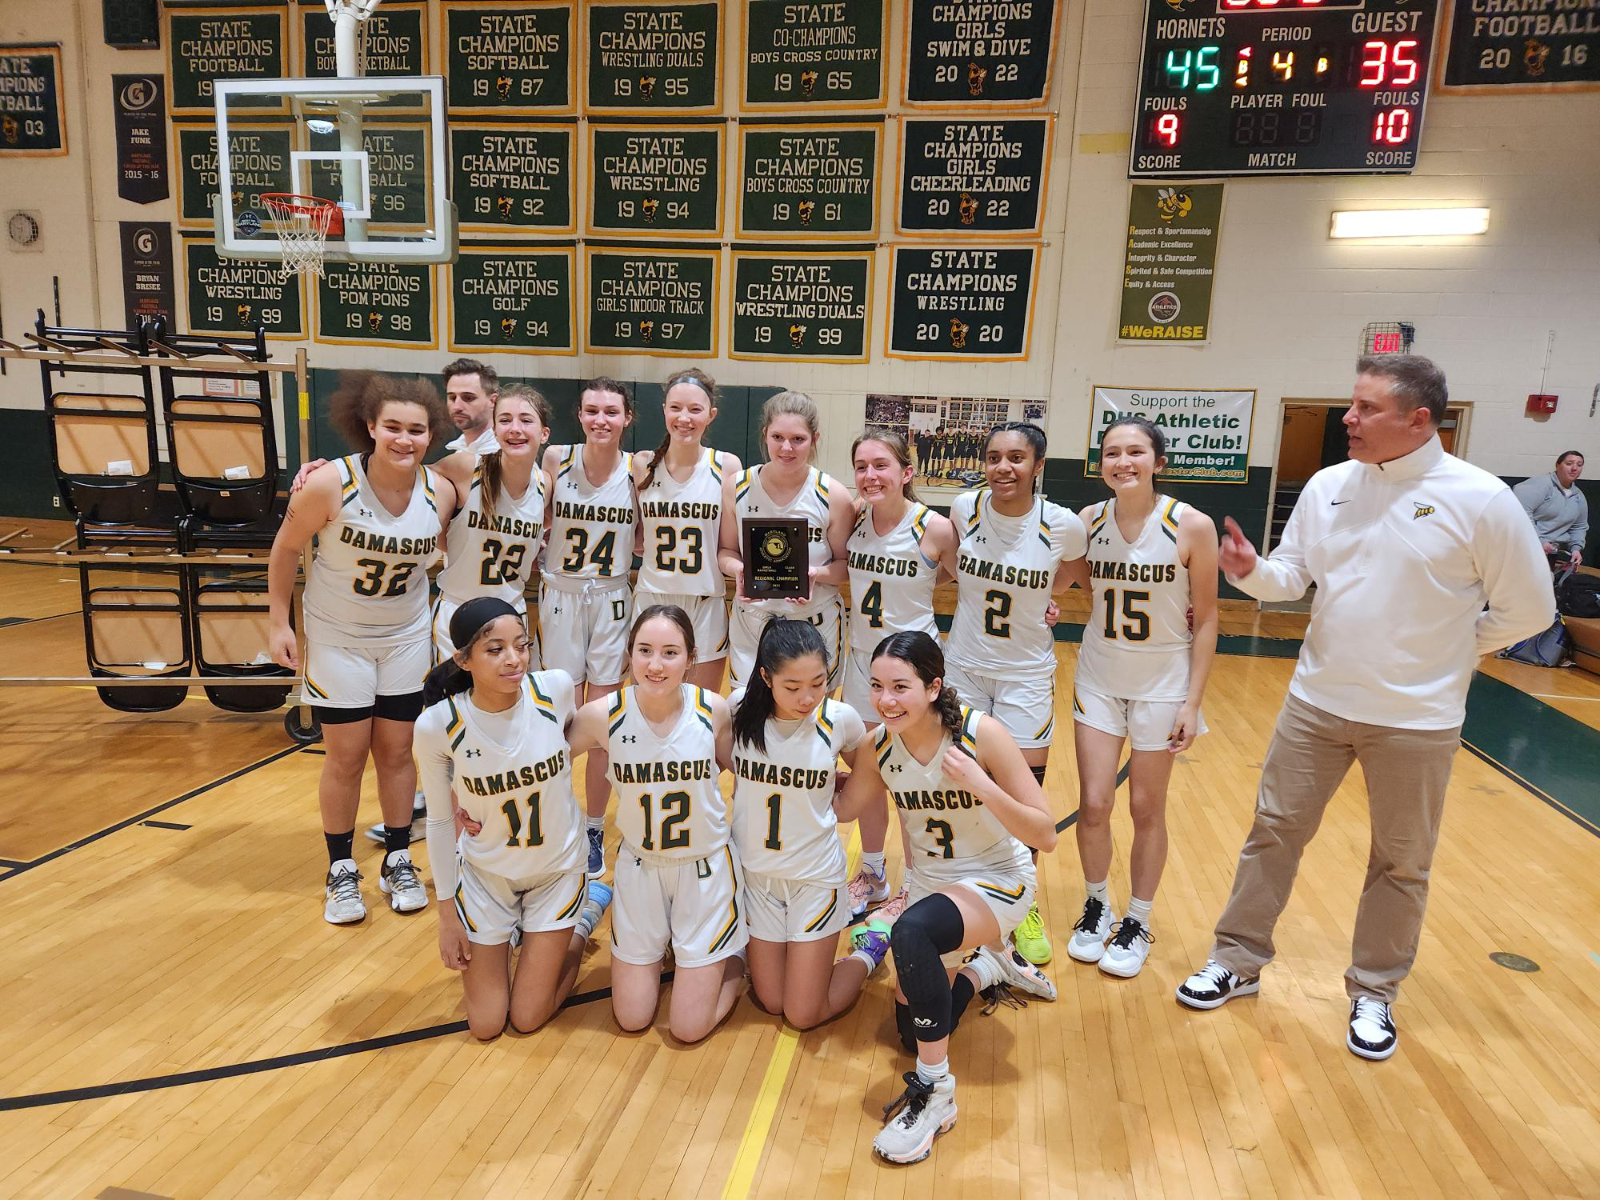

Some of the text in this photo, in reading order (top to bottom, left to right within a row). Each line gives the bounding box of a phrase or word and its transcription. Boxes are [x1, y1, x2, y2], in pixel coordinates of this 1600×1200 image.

[623, 12, 683, 31] STATE
[784, 2, 846, 24] STATE
[933, 3, 1032, 22] CHAMPIONS
[200, 21, 251, 38] STATE
[481, 15, 536, 34] STATE
[955, 21, 1006, 39] GIRLS
[1156, 17, 1226, 39] HORNETS
[1351, 12, 1423, 33] GUEST
[1473, 12, 1600, 37] FOOTBALL
[600, 31, 706, 50] CHAMPIONS
[773, 26, 856, 47] CO-CHAMPIONS
[1261, 27, 1312, 42] PERIOD
[181, 40, 272, 56] CHAMPIONS
[458, 34, 559, 54] CHAMPIONS
[927, 38, 1031, 57] SWIM & DIVE
[467, 54, 549, 71] SOFTBALL
[602, 51, 704, 68] WRESTLING DUALS
[750, 48, 878, 64] BOYS CROSS COUNTRY
[1359, 40, 1418, 87] 35
[1480, 44, 1588, 69] 20 16
[189, 58, 264, 73] FOOTBALL
[935, 63, 1019, 83] 20 22
[1166, 46, 1220, 89] 45
[1272, 51, 1293, 81] 4
[198, 81, 213, 96] 19
[473, 78, 544, 96] 19 87
[614, 78, 689, 96] 19 95
[774, 71, 852, 92] 19 65
[1144, 96, 1187, 111] FOULS
[1230, 93, 1327, 109] PLAYER FOUL
[1373, 91, 1420, 105] FOULS
[25, 119, 44, 135] 03
[131, 128, 149, 136] JAKE
[944, 125, 1003, 142] STATE
[1157, 114, 1179, 146] 9
[1375, 109, 1410, 144] 10
[483, 136, 538, 155] STATE
[626, 137, 685, 156] STATE
[779, 138, 840, 156] STATE
[924, 142, 1022, 159] CHAMPIONS
[461, 155, 560, 175] CHAMPIONS
[603, 157, 707, 176] CHAMPIONS
[754, 158, 863, 176] CHAMPIONS
[946, 159, 996, 175] GIRLS
[1138, 155, 1181, 169] SCORE
[1248, 153, 1297, 167] MATCH
[1366, 151, 1412, 166] SCORE
[124, 170, 159, 179] 2015 16
[470, 172, 550, 191] SOFTBALL
[610, 175, 700, 192] WRESTLING
[910, 175, 1031, 192] CHEERLEADING
[746, 177, 871, 195] BOYS CROSS COUNTRY
[383, 194, 405, 211] 96
[474, 196, 544, 216] 19 92
[617, 200, 690, 219] 19 94
[928, 199, 1010, 217] 20 22
[772, 203, 842, 221] 19 61
[1129, 226, 1211, 236] Respect Sportsmanship
[1128, 239, 1159, 248] Academic
[930, 251, 998, 269] STATE
[1128, 252, 1155, 262] Integrity
[136, 274, 159, 282] BRYAN
[198, 268, 287, 285] CHAMPIONS
[483, 261, 537, 278] STATE
[623, 261, 679, 279] STATE
[771, 265, 830, 283] STATE
[1126, 265, 1151, 275] Spirited
[328, 273, 420, 292] CHAMPIONS
[462, 279, 559, 297] CHAMPIONS
[601, 279, 702, 299] CHAMPIONS
[907, 274, 1017, 292] CHAMPIONS
[1124, 278, 1143, 288] Equity
[205, 285, 282, 300] WRESTLING
[340, 291, 410, 307] POM PONS
[747, 283, 853, 302] CHAMPIONS
[492, 297, 531, 312] GOLF
[597, 297, 704, 315] GIRLS INDOOR TRACK
[736, 302, 865, 319] WRESTLING DUALS
[917, 295, 1005, 311] WRESTLING
[207, 306, 282, 324] 19 99
[346, 312, 411, 331] 19 98
[474, 319, 549, 338] 19 94
[615, 321, 685, 339] 19 97
[754, 325, 842, 345] 19 99
[916, 323, 1003, 342] 20 20
[1122, 325, 1203, 338] #WeRAISE
[1130, 393, 1216, 410] Support the
[1155, 412, 1240, 429] Athletic
[1187, 434, 1242, 450] Club!
[1174, 454, 1235, 465] Member!
[555, 501, 633, 525] DAMASCUS
[643, 501, 719, 520] DAMASCUS
[340, 526, 436, 556] DAMASCUS
[656, 525, 703, 574] 23
[563, 527, 617, 577] 34
[480, 538, 526, 585] 22
[353, 558, 418, 597] 32
[958, 554, 1049, 589] DAMASCUS
[612, 600, 625, 621] D
[861, 579, 883, 628] 4
[985, 588, 1012, 639] 2
[1103, 588, 1151, 641] 15
[461, 749, 564, 797] DAMASCUS
[613, 758, 711, 784] DAMASCUS
[501, 791, 544, 848] 11
[639, 789, 692, 851] 12
[764, 792, 783, 851] 1
